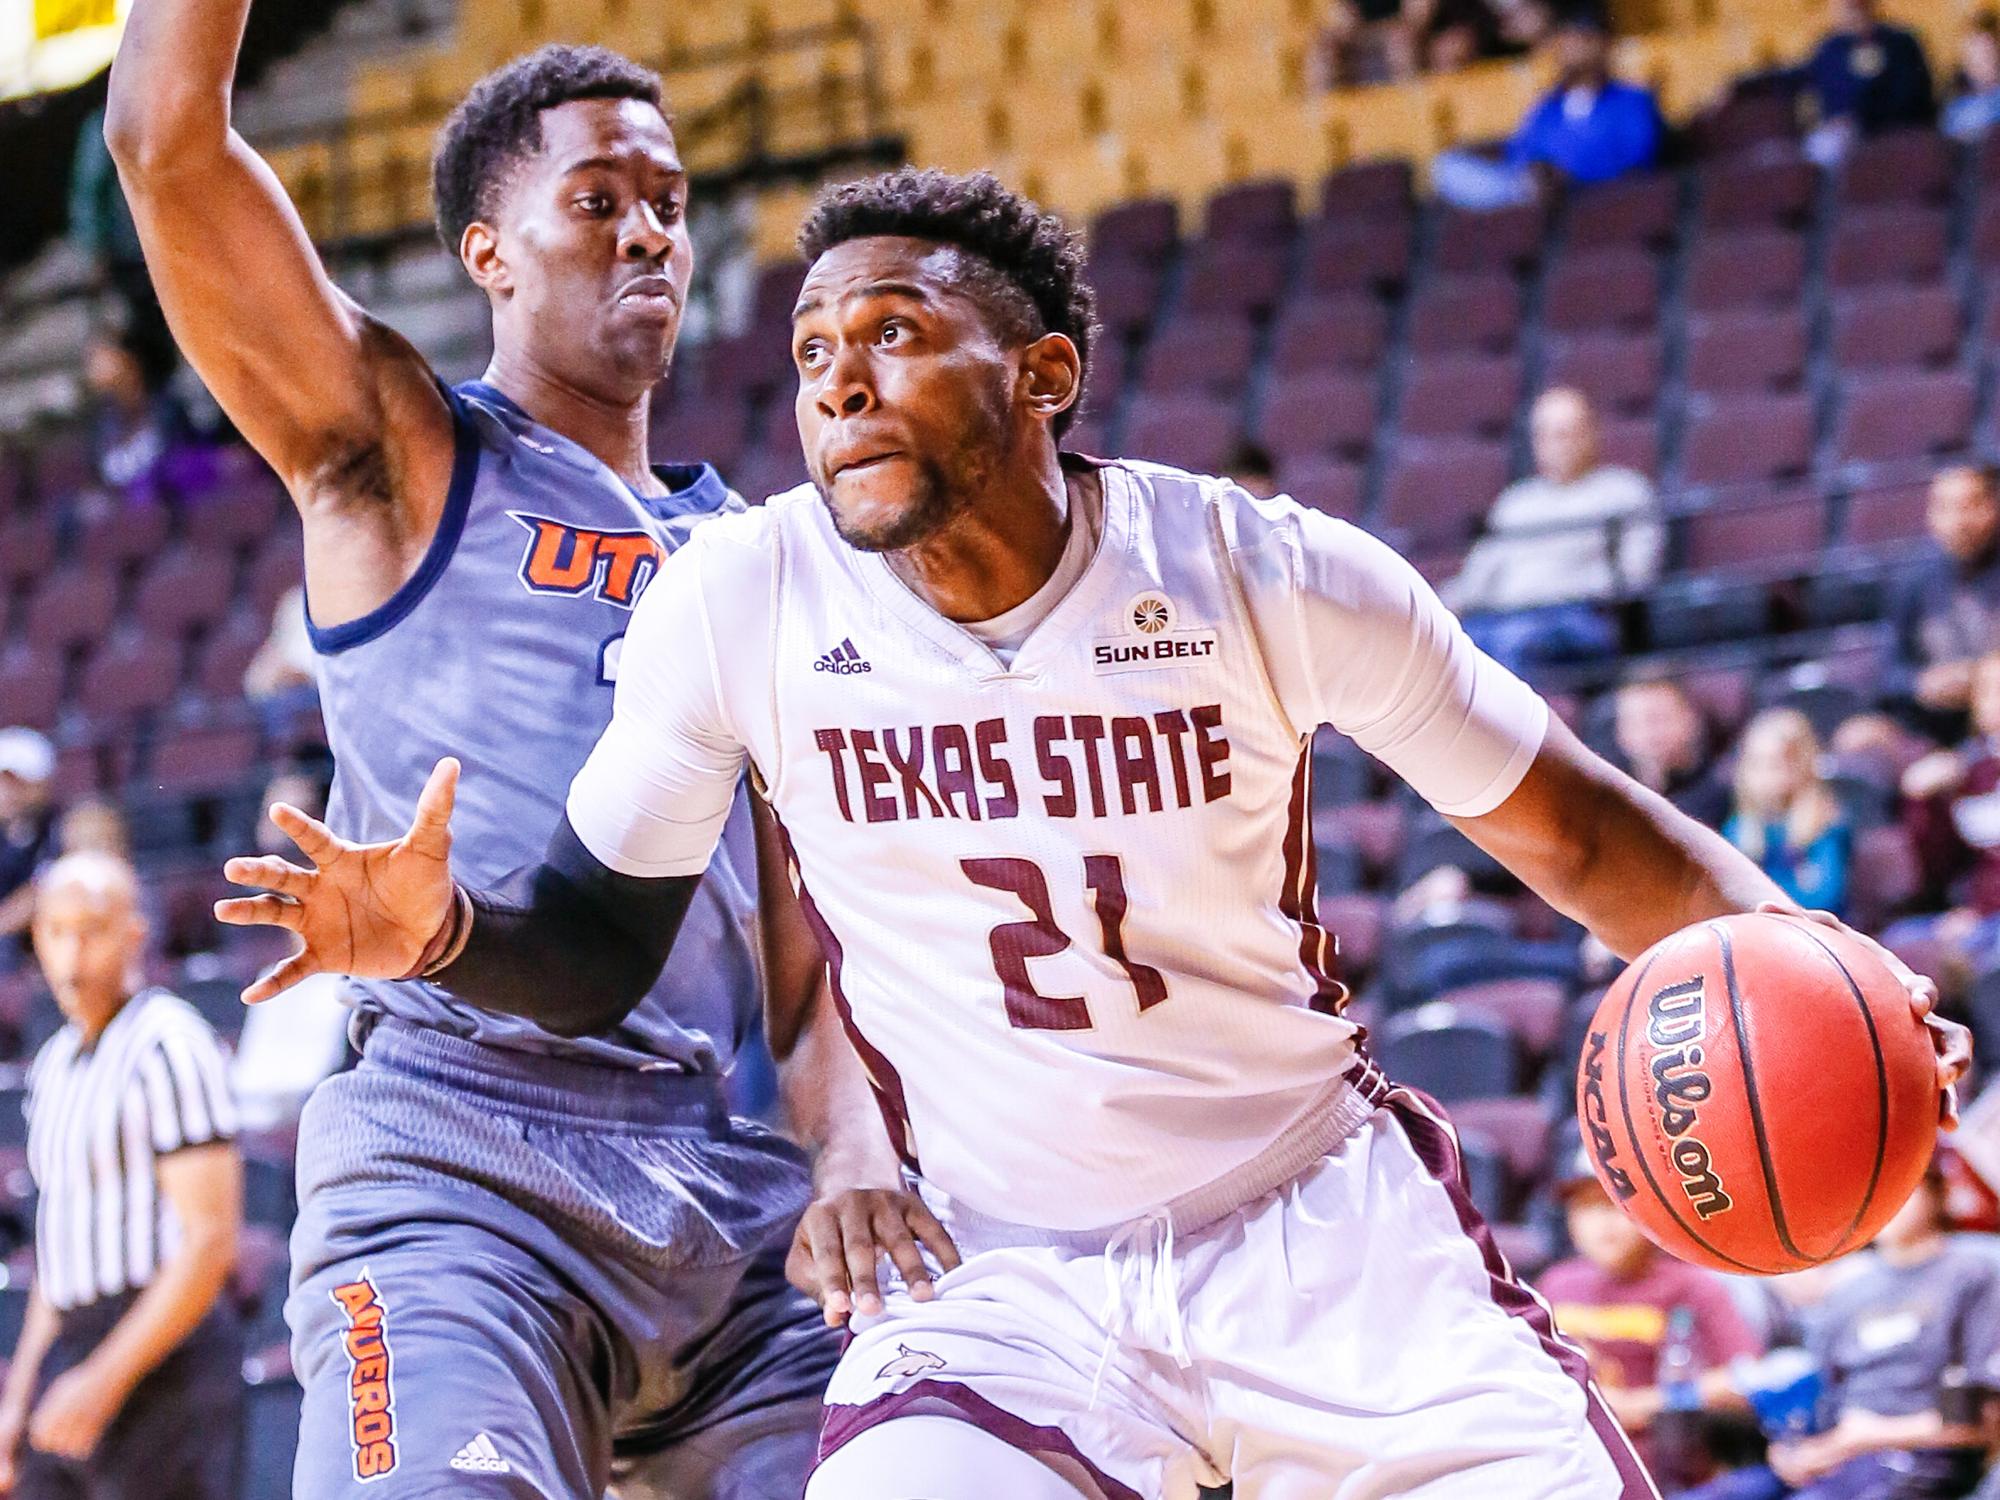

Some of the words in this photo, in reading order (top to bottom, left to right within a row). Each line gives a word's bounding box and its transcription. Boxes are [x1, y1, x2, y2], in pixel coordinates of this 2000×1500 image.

[506, 510, 668, 611] UT
[814, 660, 872, 675] adidas
[1095, 645, 1149, 664] SUN
[1154, 640, 1214, 659] BELT
[813, 718, 1019, 823] TEXAS
[1033, 704, 1232, 819] STATE
[958, 854, 1168, 1030] 21
[1584, 1031, 1638, 1200] NCAA
[1647, 974, 1734, 1221] Wilson
